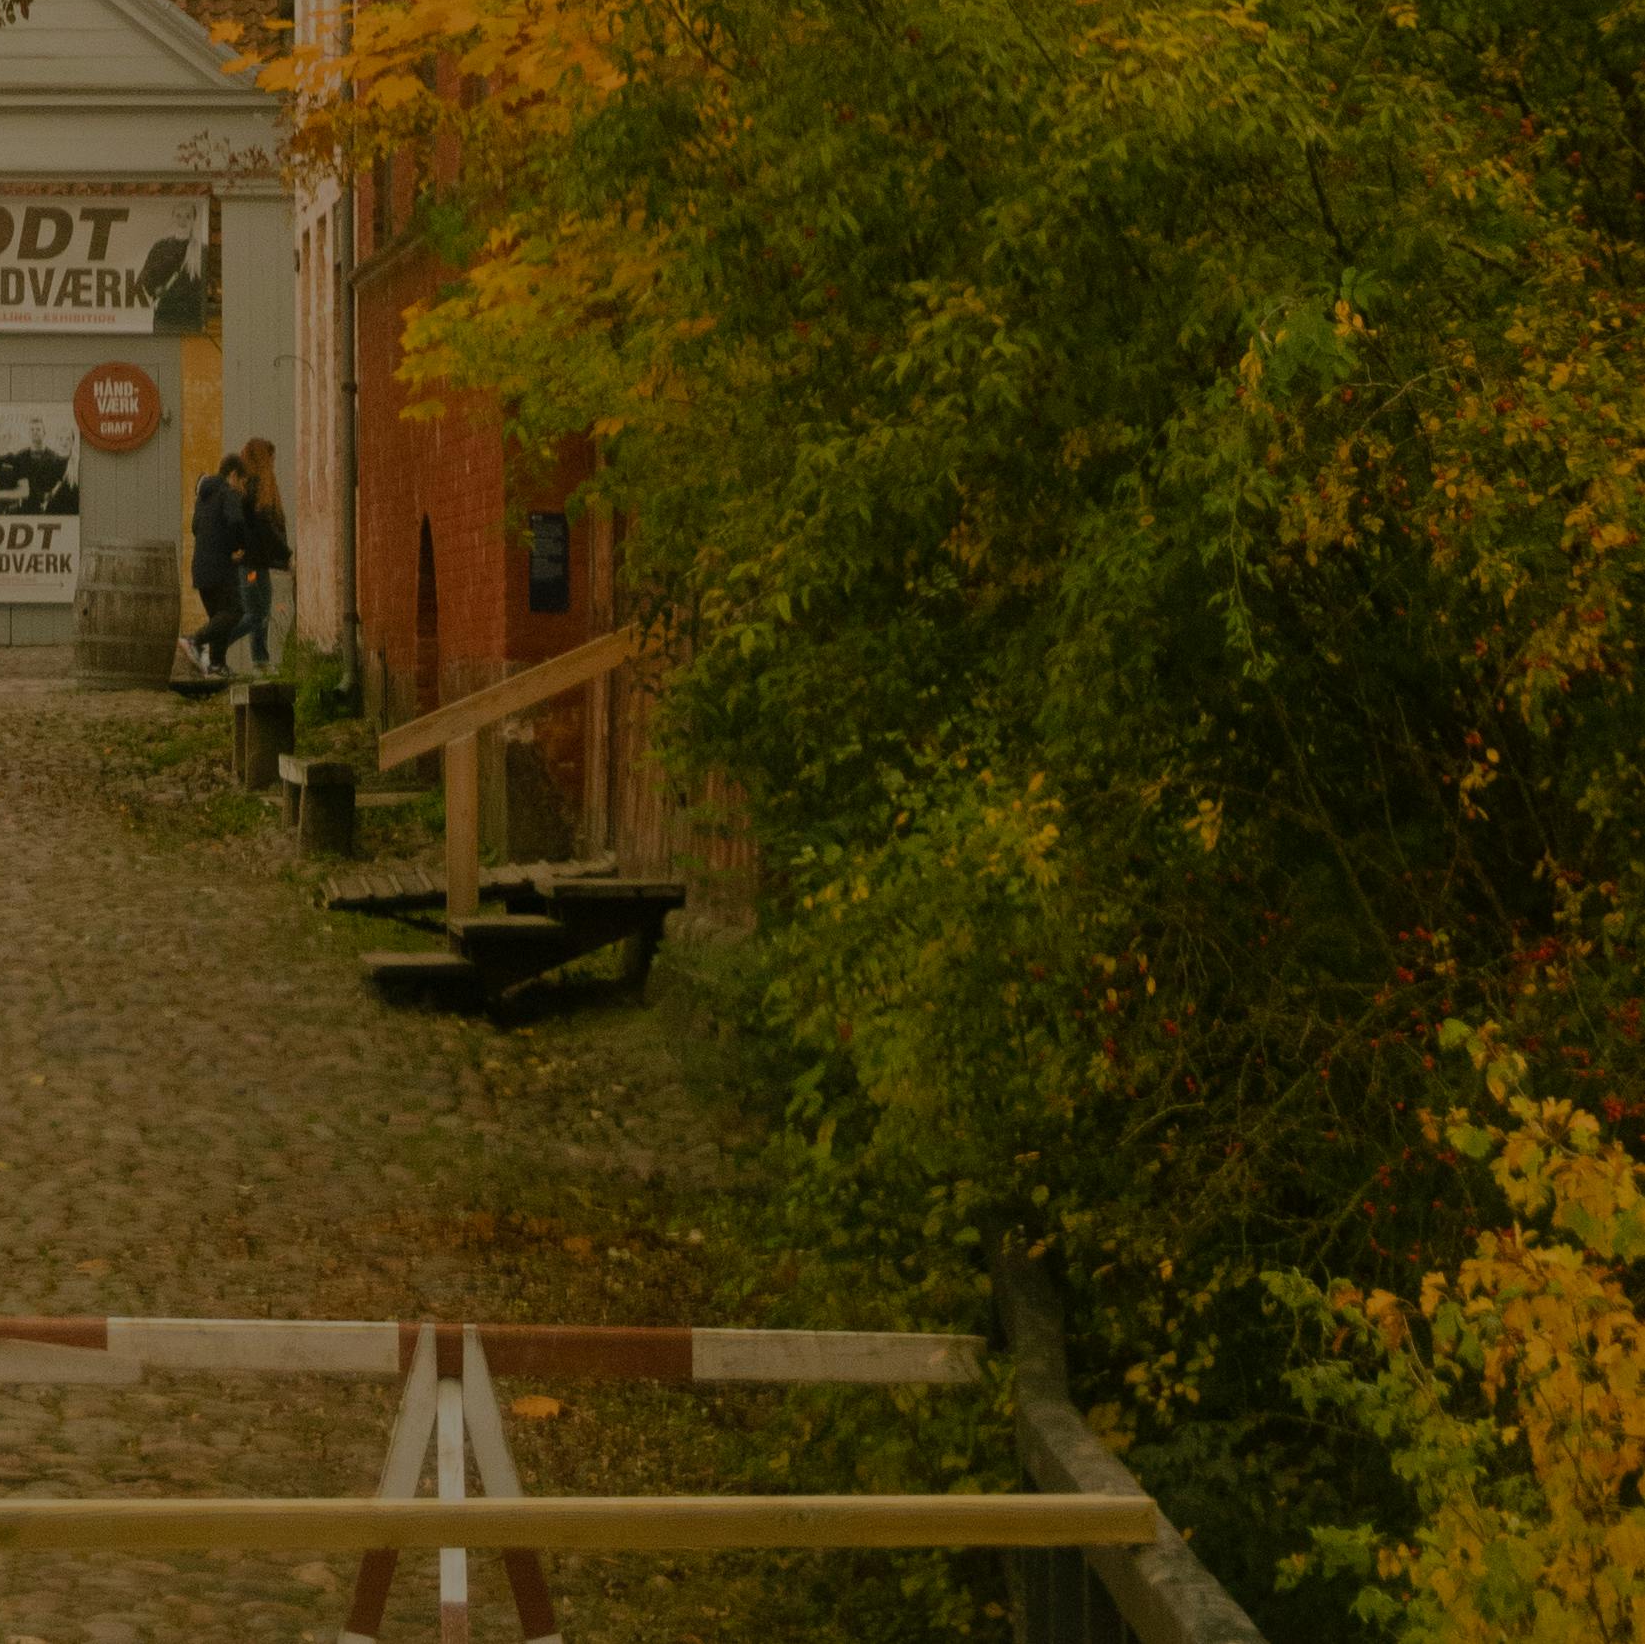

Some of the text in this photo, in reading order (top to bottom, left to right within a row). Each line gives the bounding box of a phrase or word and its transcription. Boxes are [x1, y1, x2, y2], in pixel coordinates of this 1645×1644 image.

[42, 312, 117, 325] EXHIBITION
[93, 376, 140, 398] HÅND-
[96, 396, 140, 414] VÆRK
[100, 421, 134, 436] CRAFT
